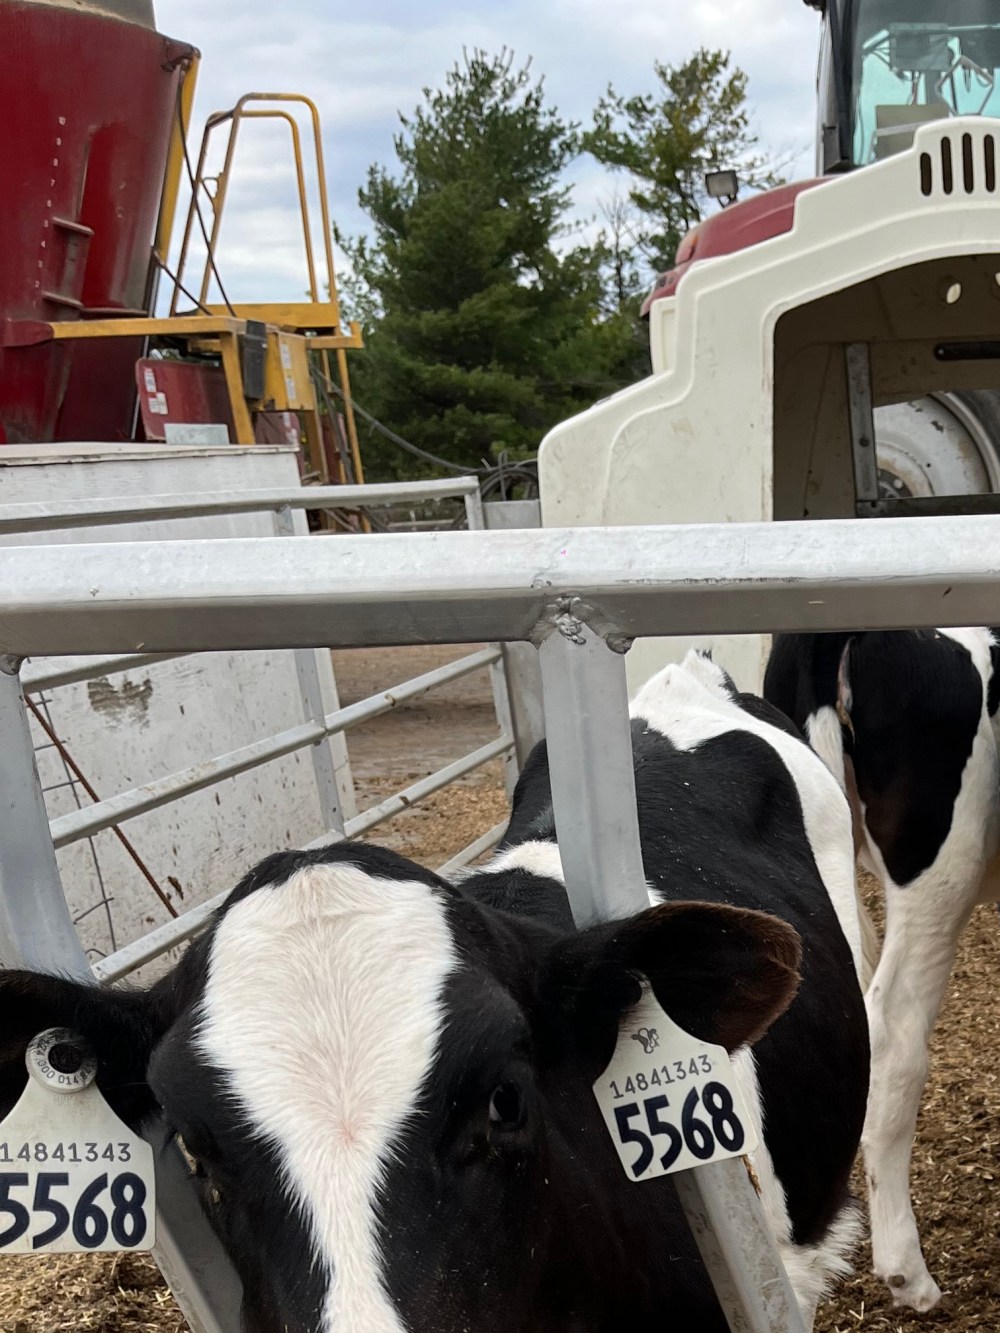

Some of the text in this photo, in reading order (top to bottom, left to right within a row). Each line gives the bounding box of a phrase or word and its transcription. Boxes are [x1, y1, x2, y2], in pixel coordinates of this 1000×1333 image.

[609, 1054, 712, 1099] 14841343
[0, 1142, 131, 1163] 14841343
[613, 1081, 745, 1178] 5568
[0, 1172, 147, 1250] 5568
